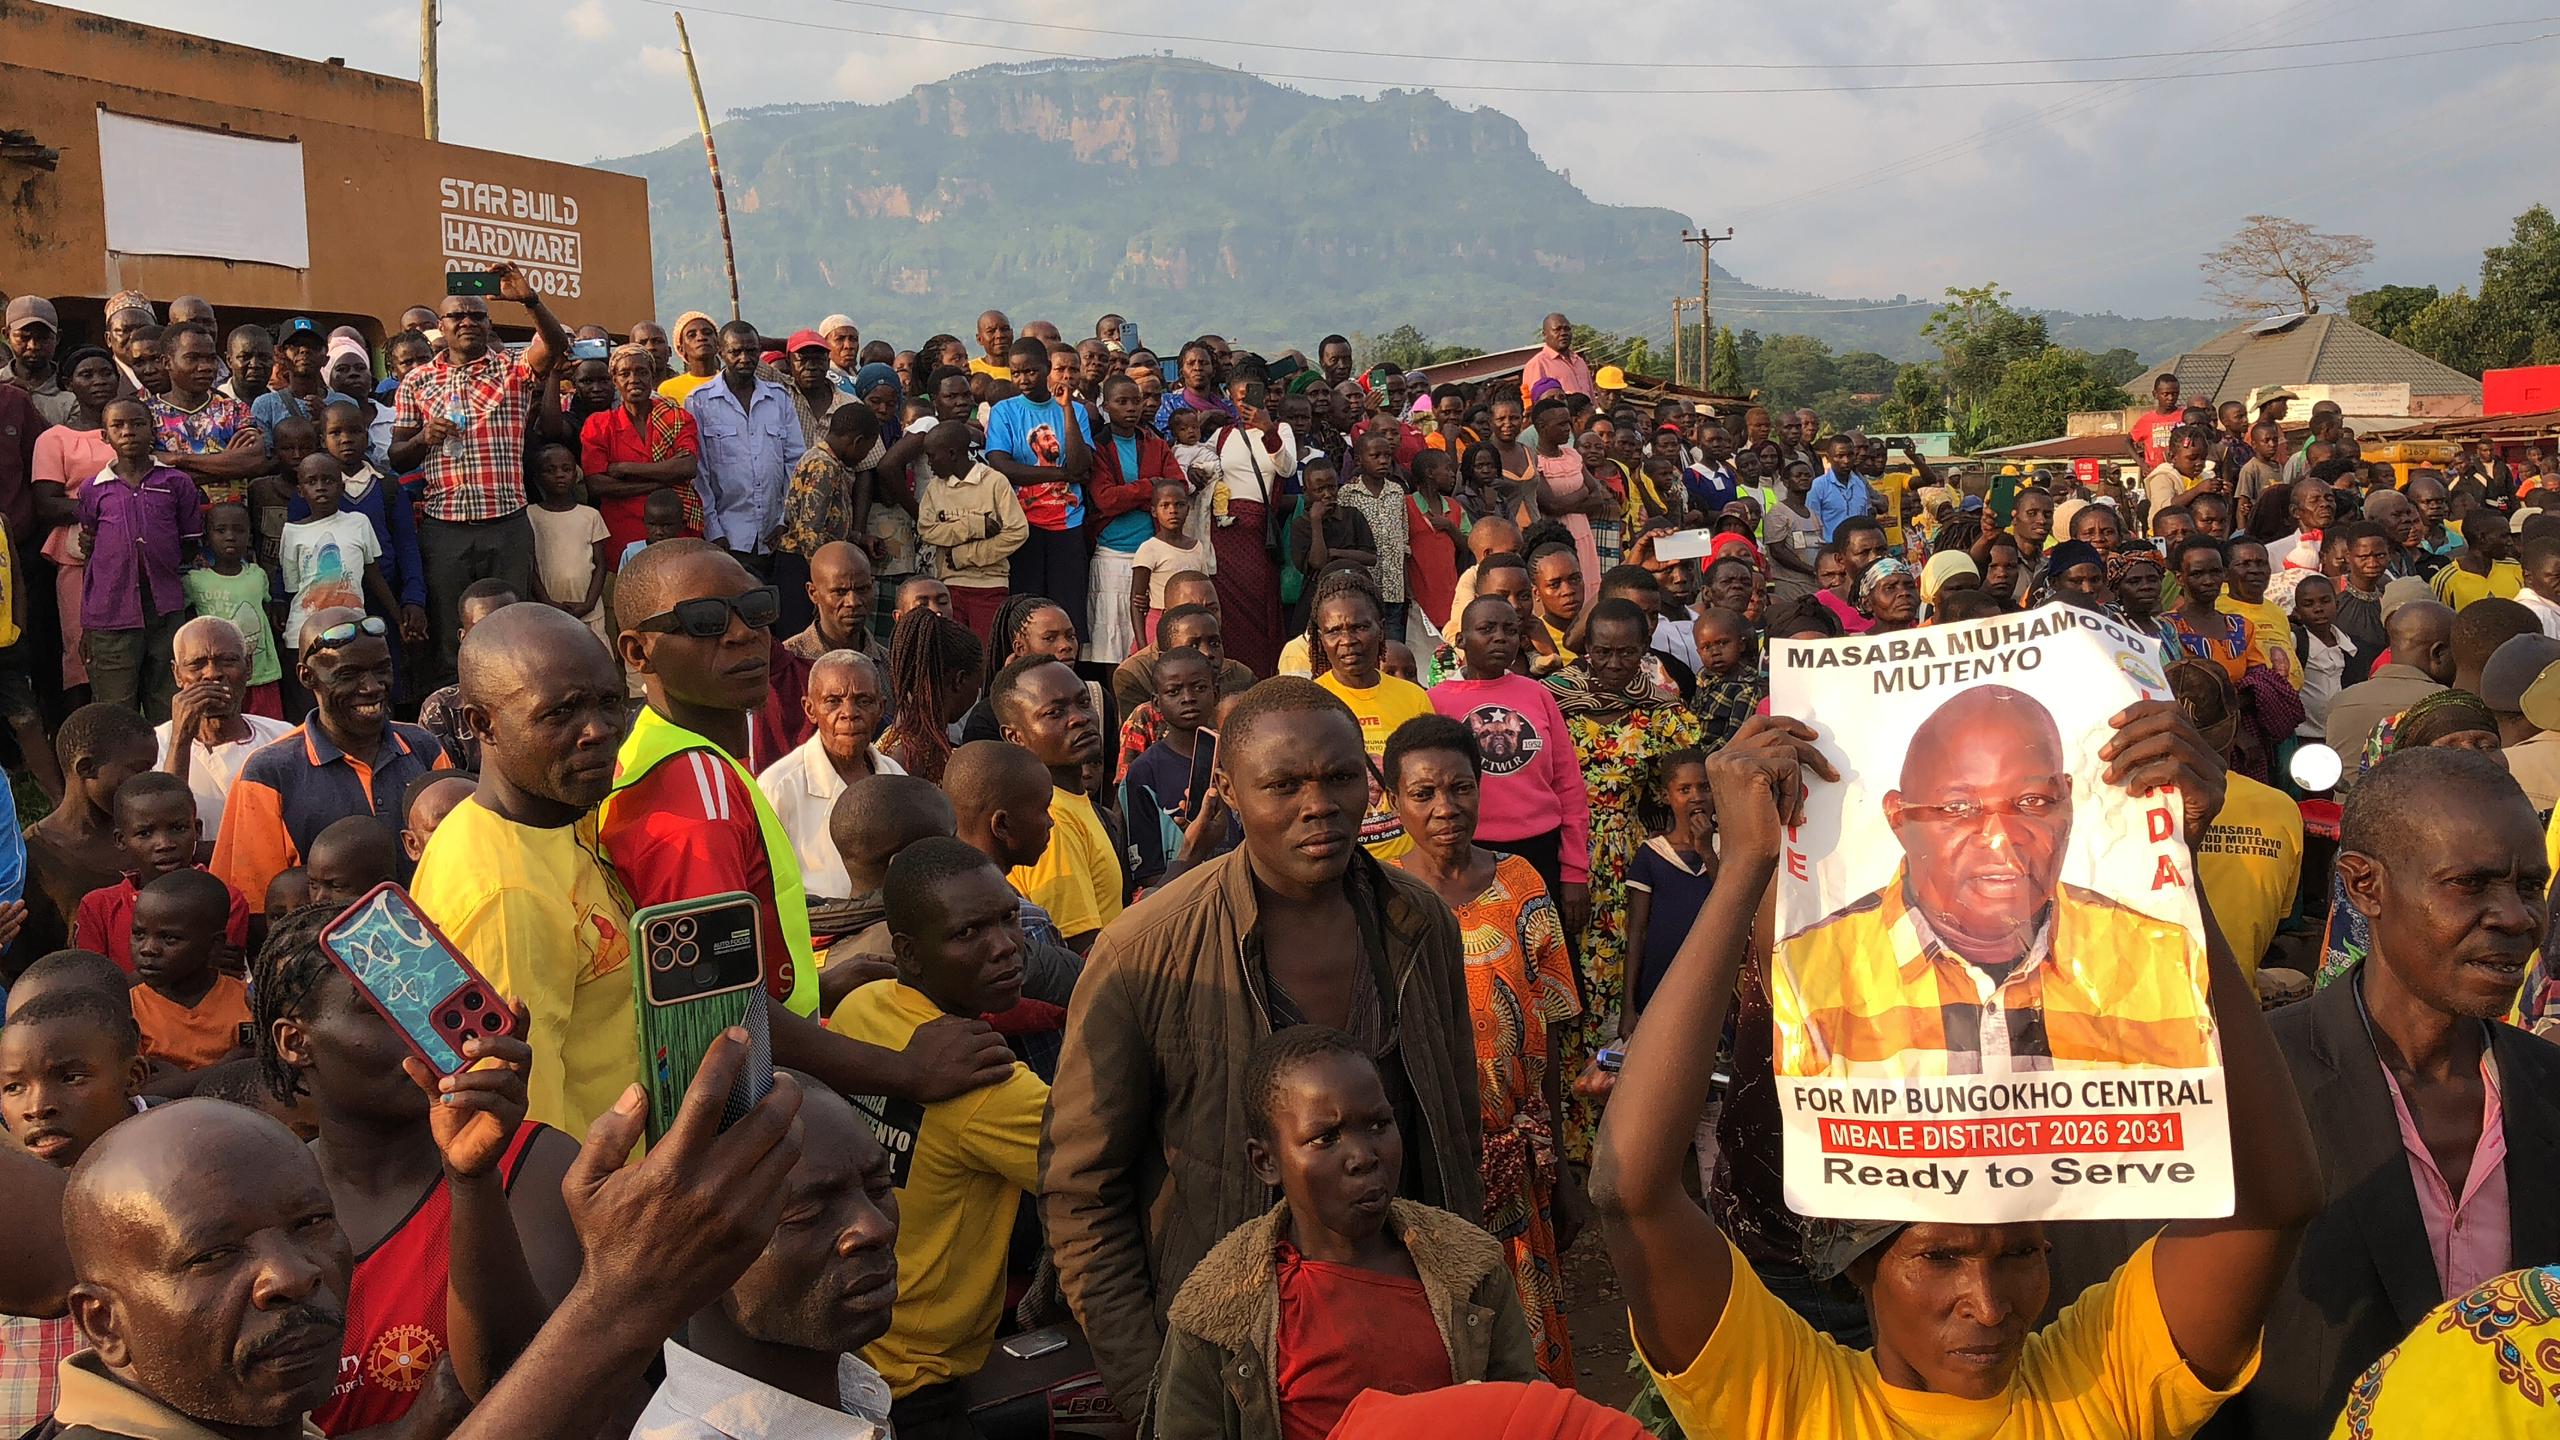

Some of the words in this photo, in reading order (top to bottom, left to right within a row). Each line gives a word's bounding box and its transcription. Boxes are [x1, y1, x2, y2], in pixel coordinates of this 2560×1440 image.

[440, 177, 509, 216] STAR
[511, 188, 579, 226] BUILD
[447, 220, 577, 265] HARDWARE
[1787, 638, 1936, 669] MASABA
[1947, 610, 2146, 657] MUHAMOOD
[1873, 646, 2042, 695] MUTENYO
[1359, 716, 1381, 726] OTE
[2225, 835, 2282, 850] MUTENYO
[2225, 844, 2279, 859] CENTRAL
[1793, 1086, 1845, 1114] FOR
[1852, 1088, 1898, 1114] MP
[1906, 1082, 2074, 1114] BUNGOKHO
[2080, 1078, 2213, 1108] CENTRAL
[1829, 1122, 1915, 1150] MBALE
[1922, 1121, 2042, 1151] DISTRICT
[2050, 1119, 2109, 1146] 2026
[2117, 1118, 2176, 1145] 2031
[1822, 1157, 1970, 1196] Ready
[1986, 1161, 2034, 1189] to
[2051, 1157, 2196, 1186] Serve
